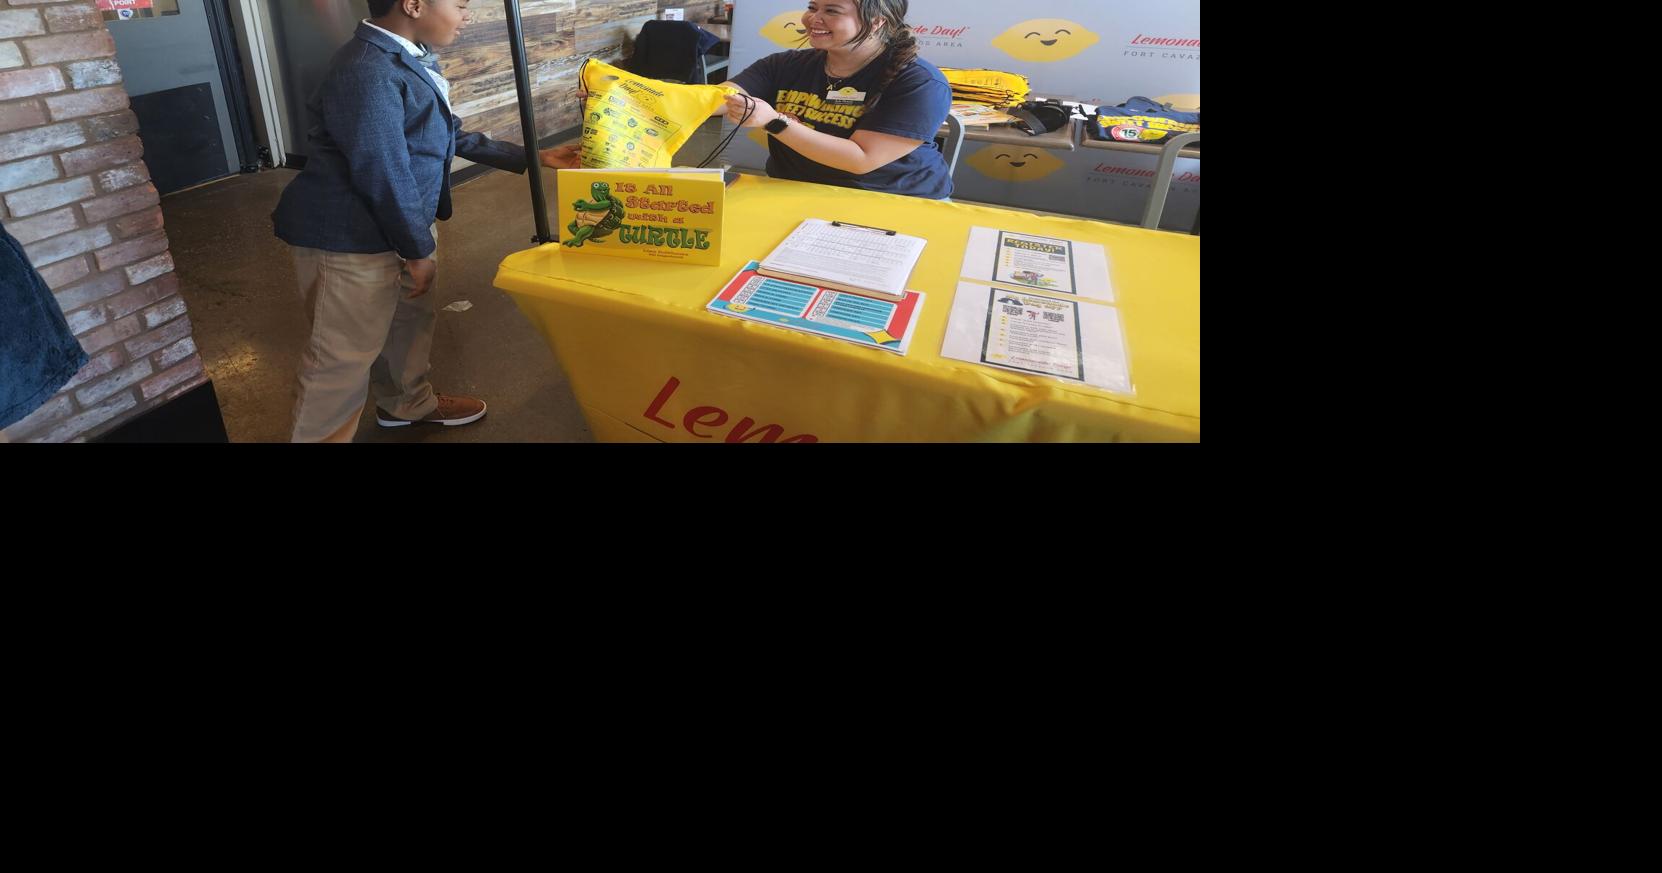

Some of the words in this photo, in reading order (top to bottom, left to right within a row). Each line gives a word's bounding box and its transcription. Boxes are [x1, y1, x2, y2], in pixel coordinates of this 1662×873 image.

[931, 25, 966, 38] Day!
[1130, 33, 1200, 48] Lemona
[1123, 50, 1155, 58] FORT
[1121, 129, 1137, 138] 15
[1094, 162, 1156, 178] Lemona
[619, 223, 711, 250] TURTLE
